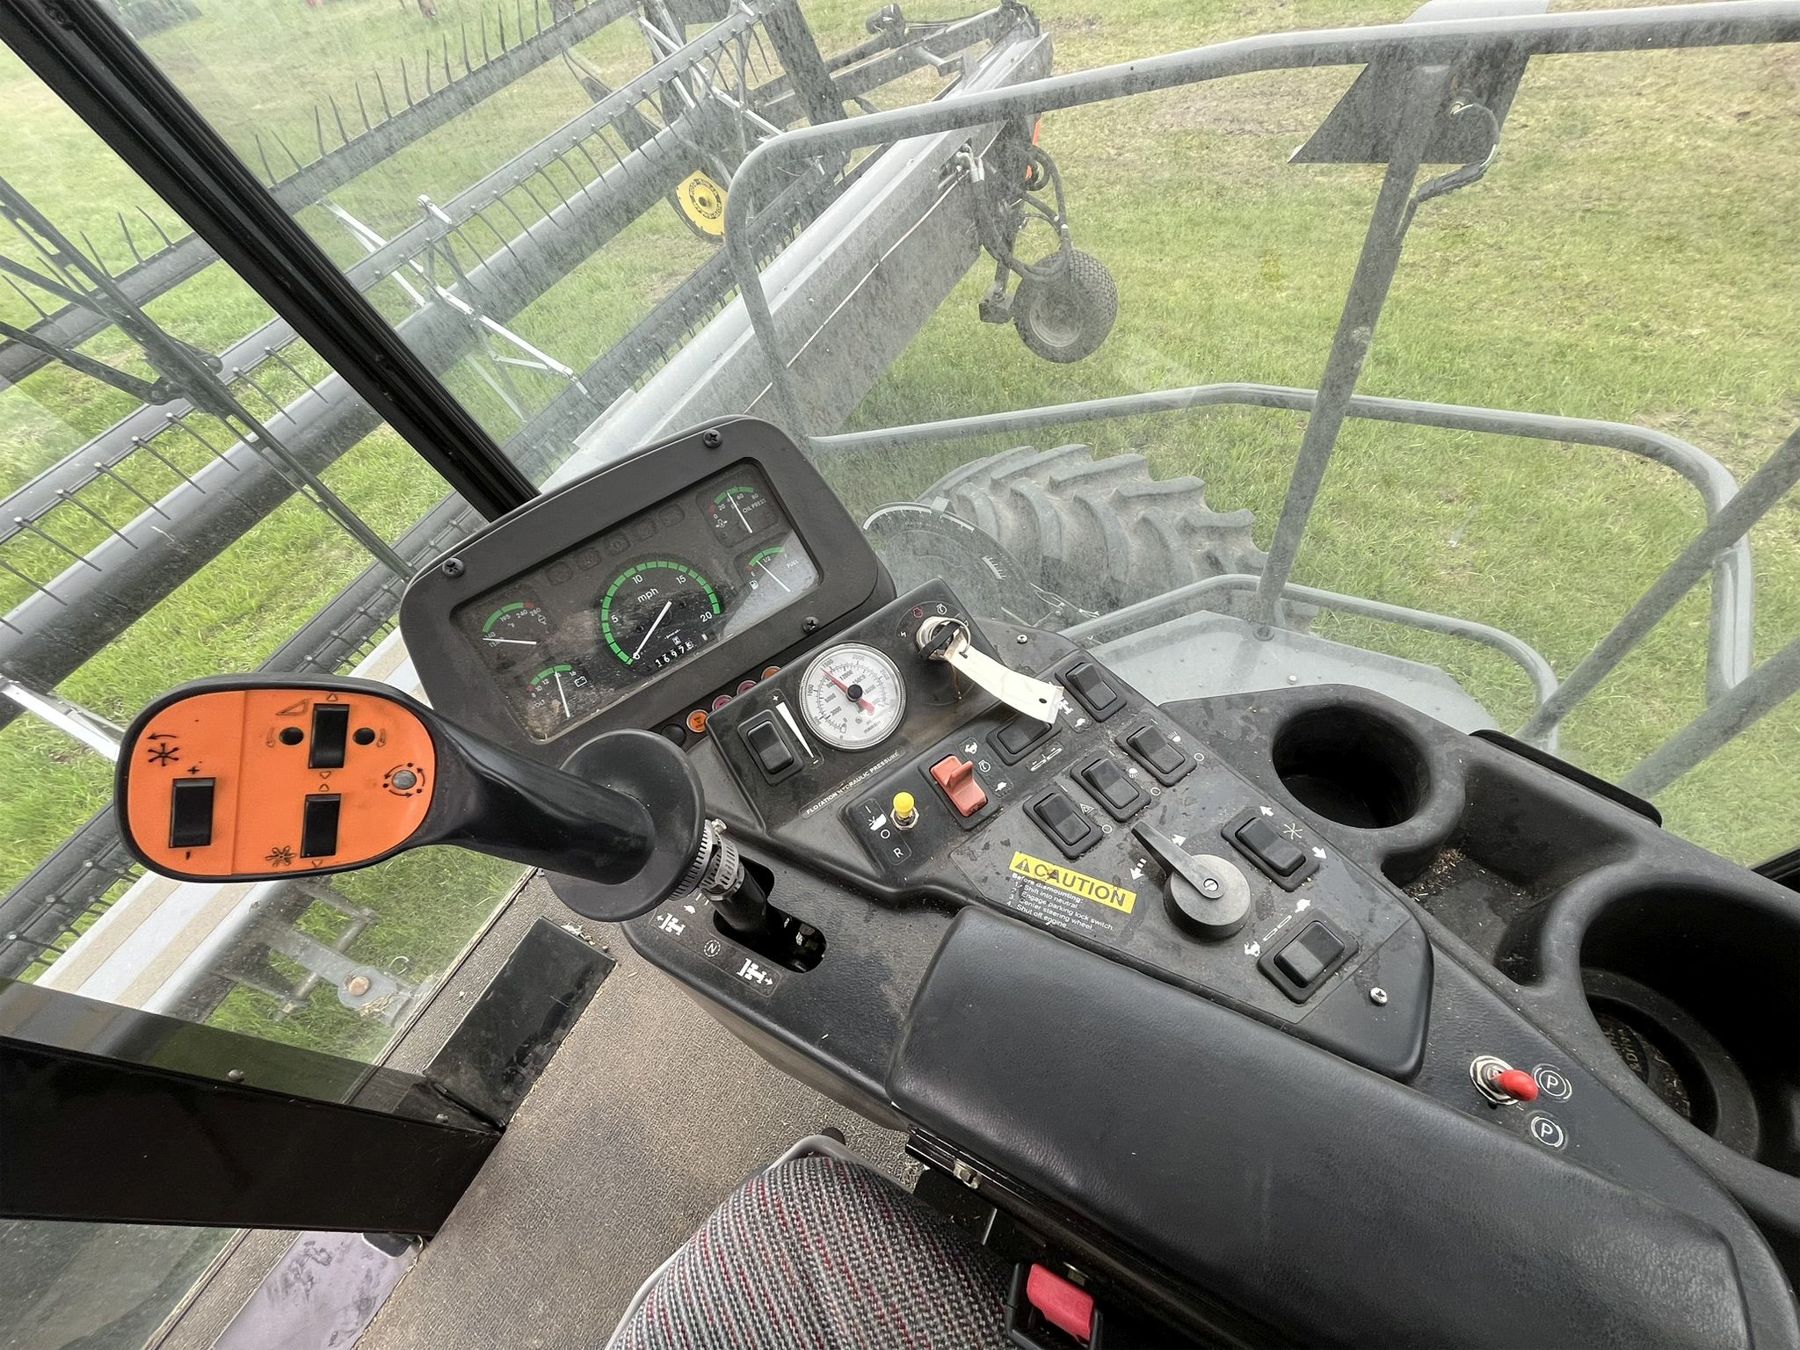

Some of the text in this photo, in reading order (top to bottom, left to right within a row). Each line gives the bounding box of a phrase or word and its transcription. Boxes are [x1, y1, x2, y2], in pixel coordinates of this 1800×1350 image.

[632, 574, 643, 585] 10
[676, 574, 687, 585] 15
[637, 587, 659, 603] mph
[611, 614, 619, 623] 5
[700, 611, 713, 623] 20
[806, 791, 838, 815] FLOTATION
[869, 750, 900, 774] PRESSURE
[893, 847, 904, 858] R
[1012, 872, 1034, 886] Before
[1034, 864, 1126, 907] CAUTION
[1024, 885, 1039, 895] Shift
[1040, 890, 1052, 900] into
[1016, 904, 1032, 915] Shut
[1033, 911, 1044, 920] off
[1020, 898, 1041, 911] Center
[1043, 907, 1070, 922] steering
[1021, 891, 1047, 905] Engage
[1048, 902, 1074, 916] parking
[1074, 910, 1089, 921] lock
[707, 943, 717, 954] N
[1546, 1074, 1559, 1089] P
[1540, 1122, 1553, 1137] P
